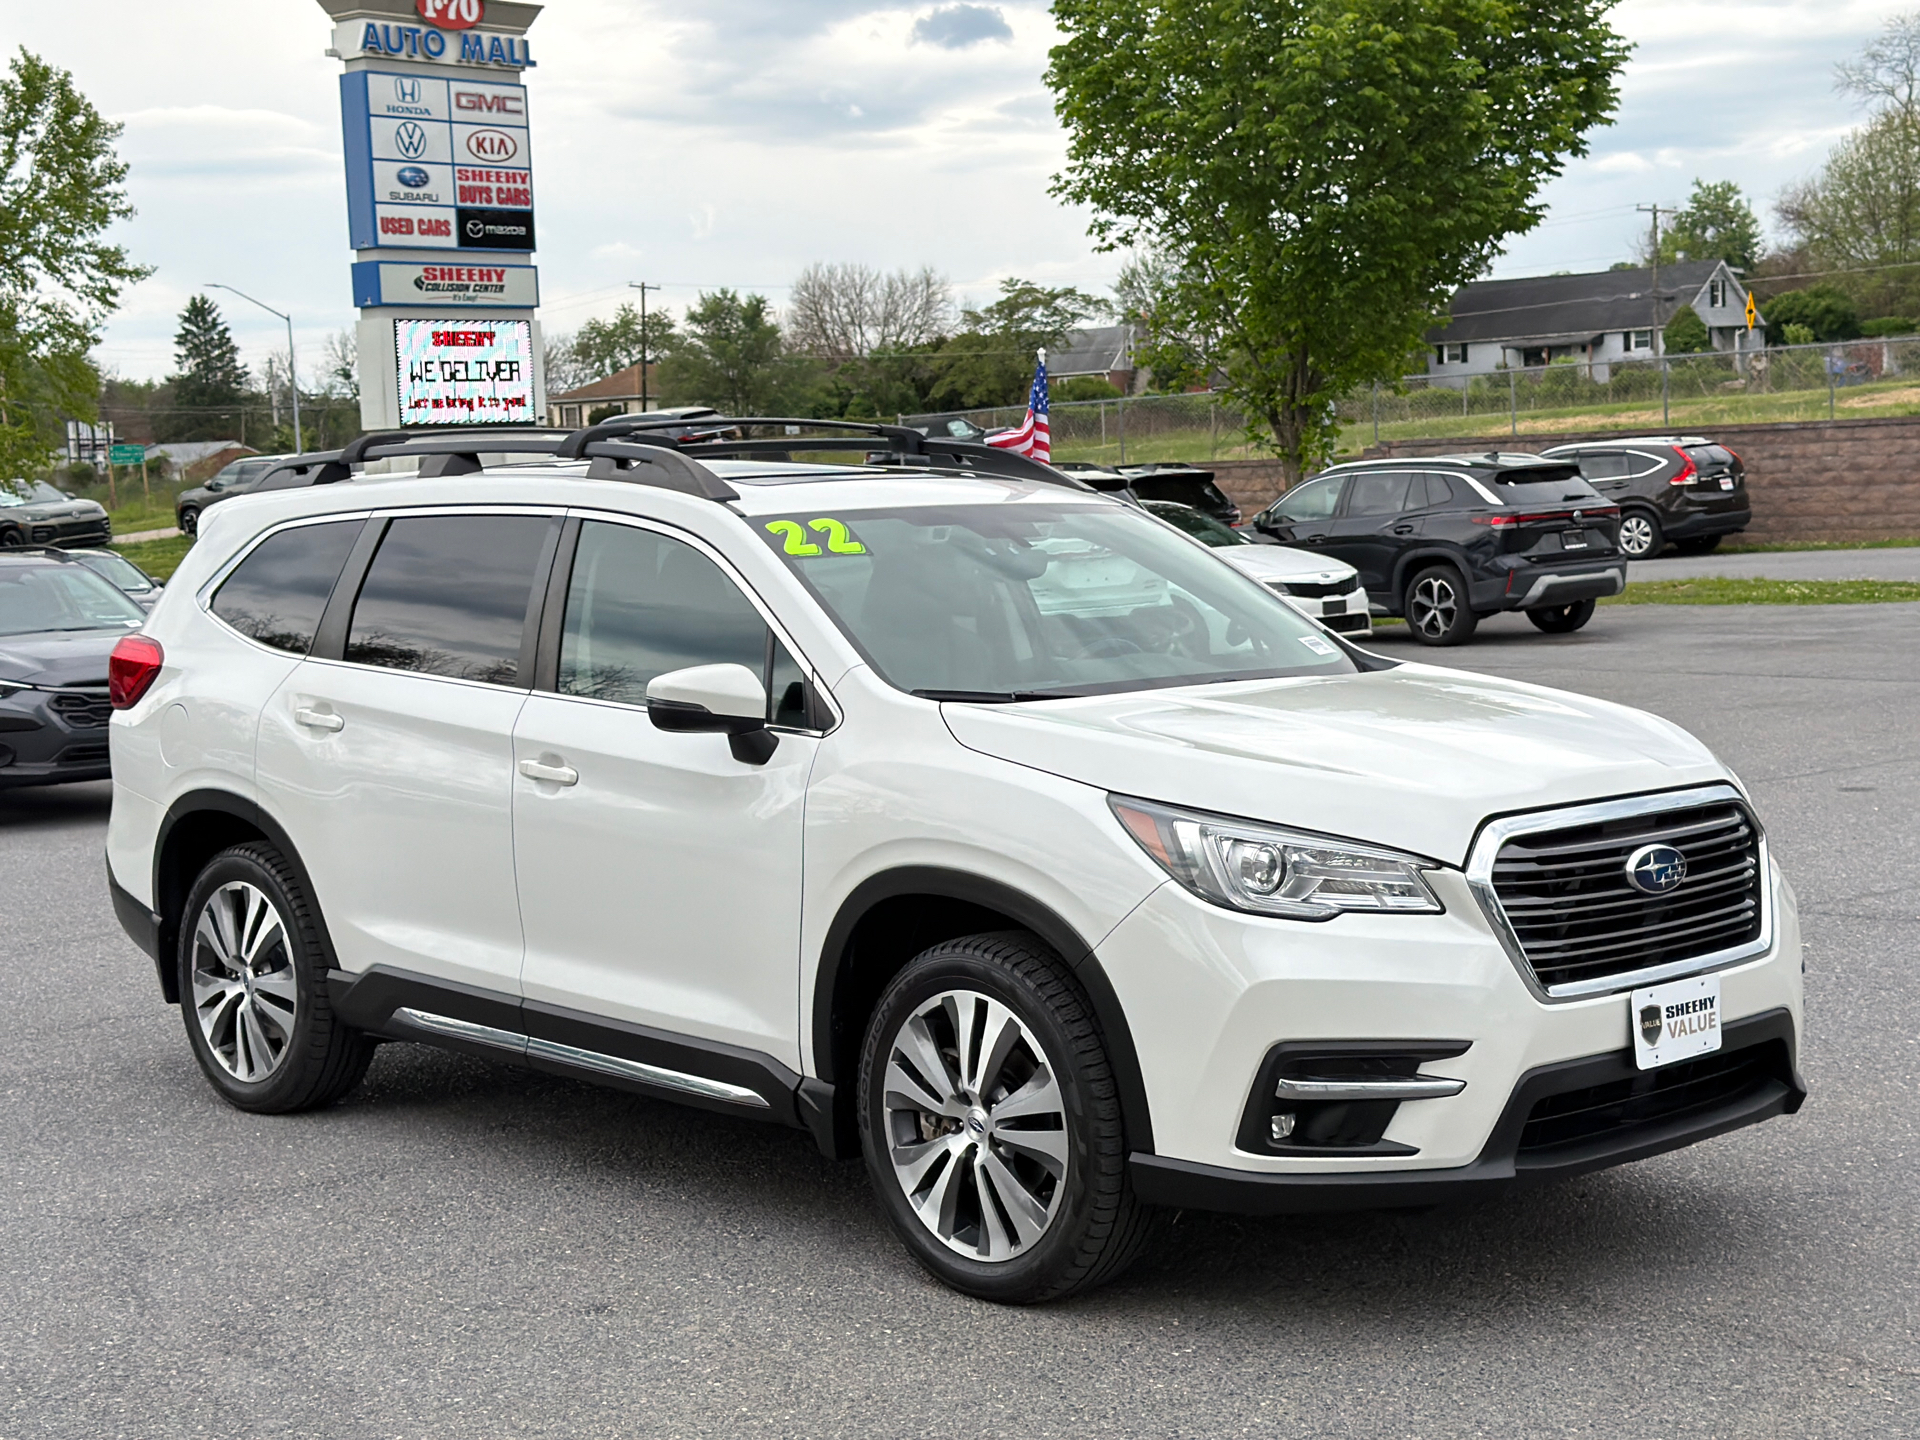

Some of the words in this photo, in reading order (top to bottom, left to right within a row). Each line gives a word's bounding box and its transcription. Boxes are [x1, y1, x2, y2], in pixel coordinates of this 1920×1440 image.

[362, 22, 447, 59] AUTO
[460, 32, 537, 67] MALL
[386, 104, 432, 116] HONDA
[455, 92, 524, 116] GMC
[475, 136, 510, 156] KIA
[457, 168, 529, 185] SHEEHY
[389, 191, 439, 203] SUBARU
[458, 184, 494, 205] BUYS
[496, 186, 531, 207] CARS
[380, 216, 415, 235] USED
[417, 217, 451, 237] CARS
[484, 225, 527, 236] mazda
[423, 266, 506, 283] SHEEHY
[424, 282, 471, 292] COLLISION
[472, 283, 506, 294] CENTER
[431, 330, 496, 347] SHEEHY
[410, 360, 437, 382] WE
[440, 360, 521, 382] DELIVER
[765, 517, 867, 557] 22
[1665, 995, 1717, 1020] SHEEHY
[1666, 1011, 1717, 1039] VALUE
